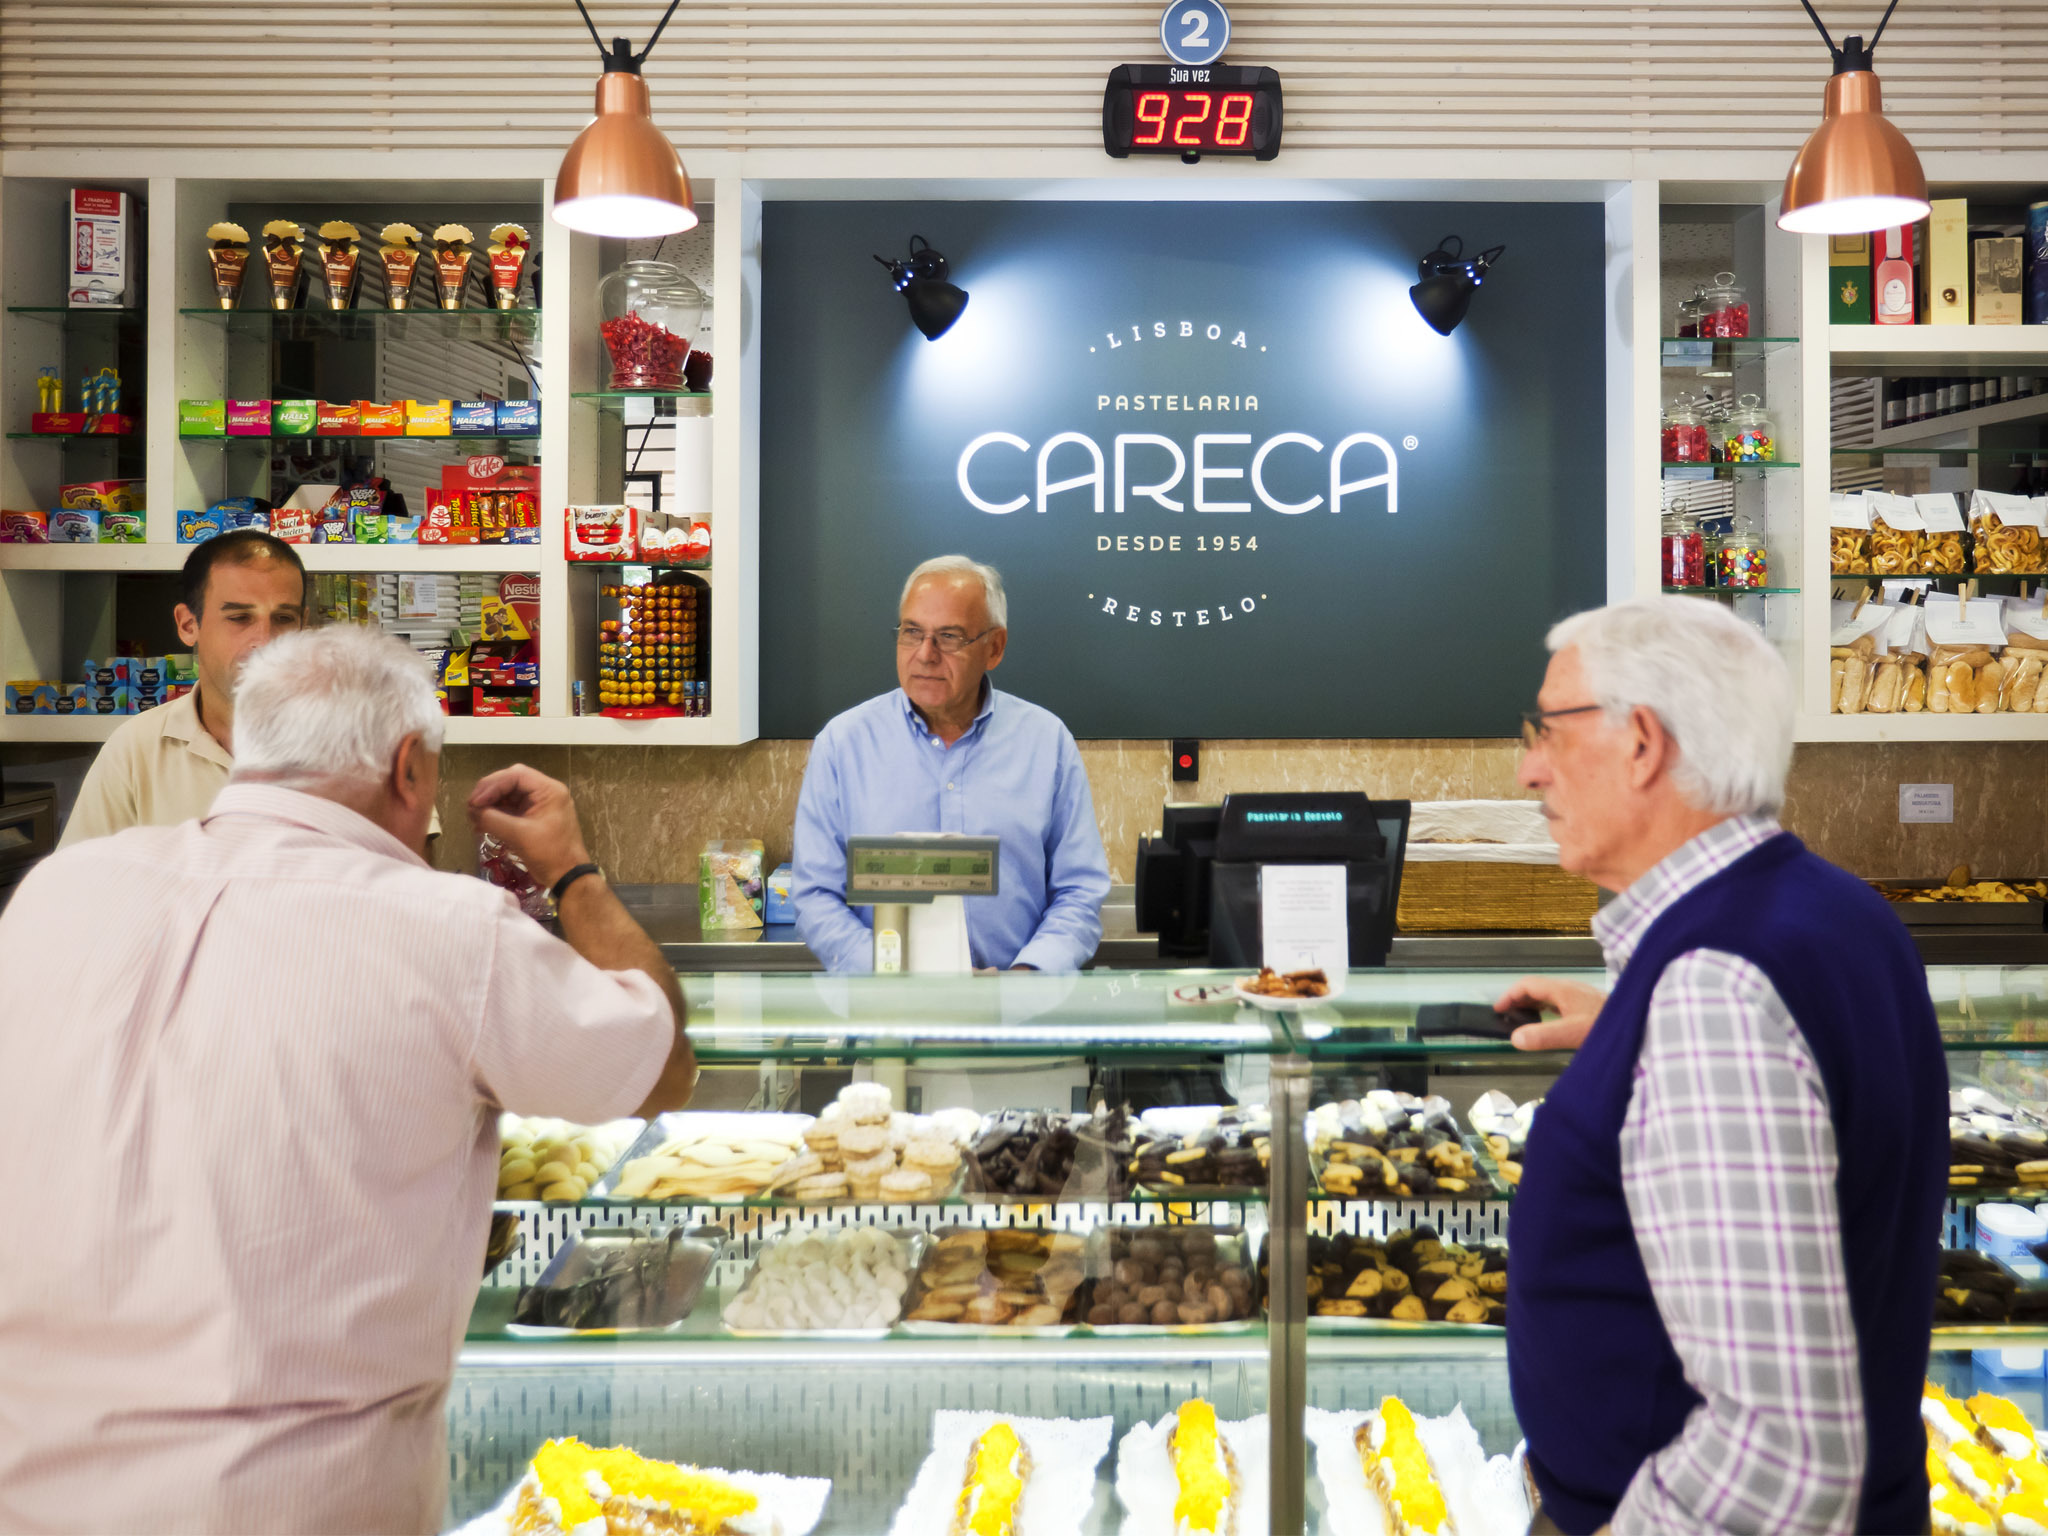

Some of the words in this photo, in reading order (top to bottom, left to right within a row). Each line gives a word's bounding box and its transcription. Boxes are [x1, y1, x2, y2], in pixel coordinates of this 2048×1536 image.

[1181, 10, 1209, 47] 2
[1170, 67, 1189, 82] Sua
[1192, 70, 1210, 82] vez
[1134, 92, 1253, 145] 928
[1107, 320, 1248, 349] LISBOA
[1097, 395, 1259, 411] PASTELARIA
[456, 417, 483, 425] HALLS
[501, 416, 527, 425] HALLS
[473, 457, 500, 477] KitKat
[957, 432, 1398, 514] CARECA
[584, 511, 608, 520] bueno
[277, 527, 304, 538] Chiclets
[1097, 536, 1182, 551] DESDE
[1197, 536, 1259, 551] 1954
[1102, 597, 1256, 627] RESTELO
[1247, 812, 1301, 822] Pastelaria
[1304, 811, 1343, 821] Restelo
